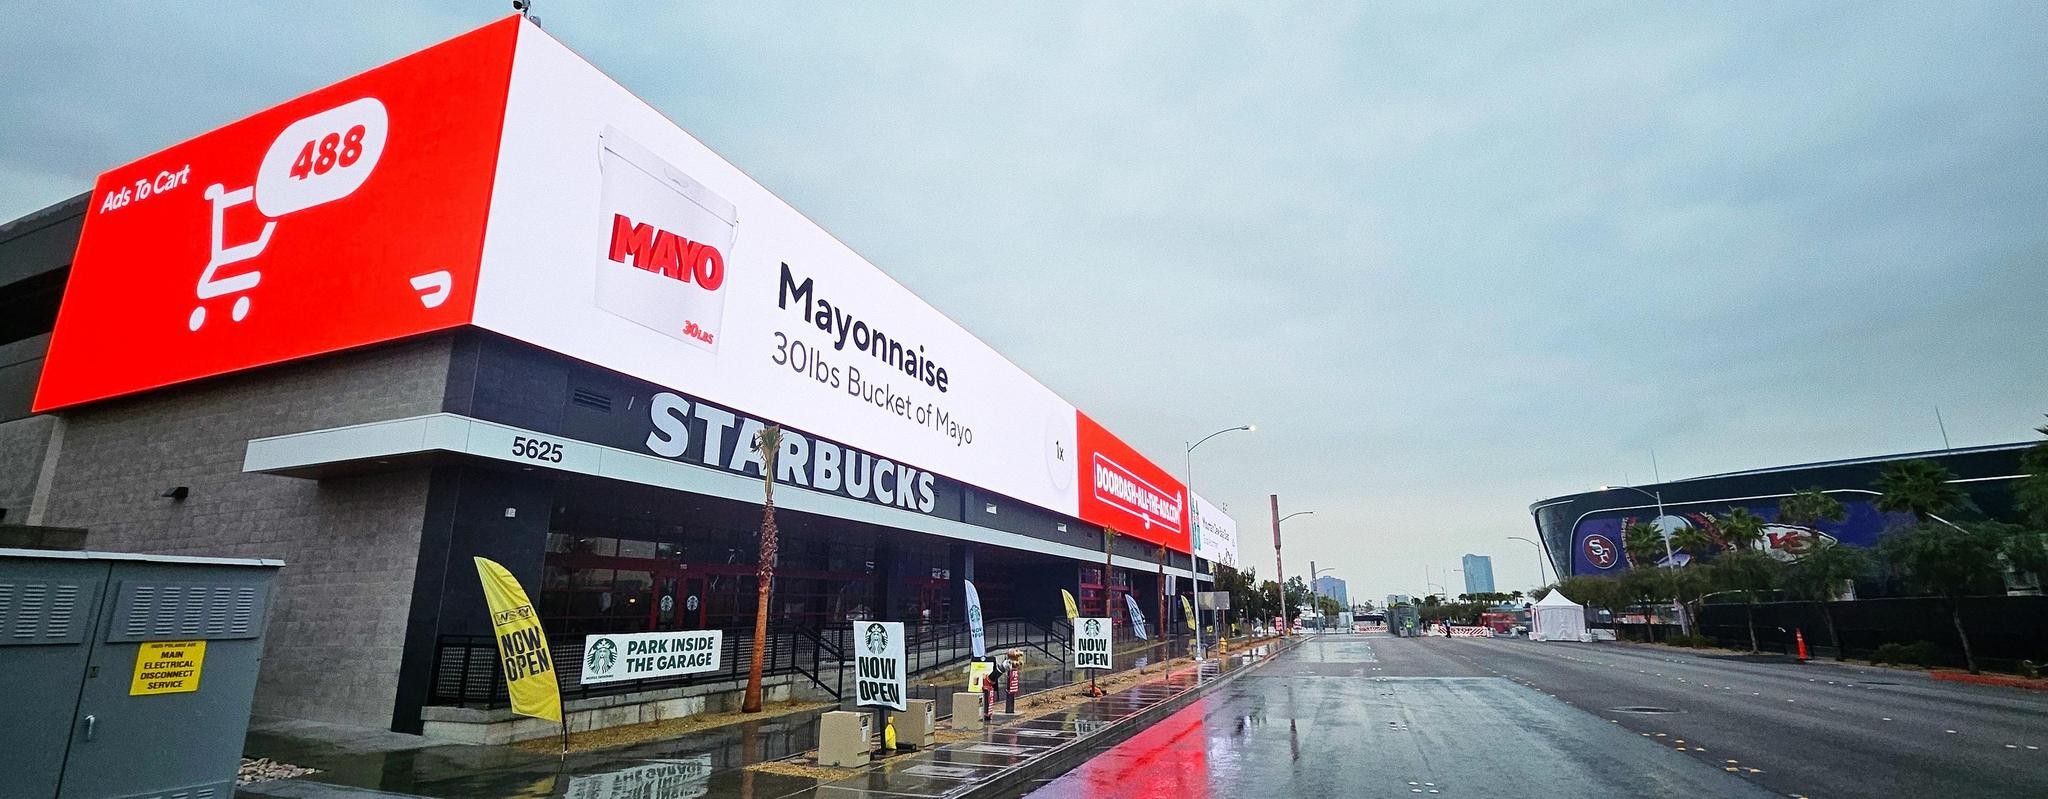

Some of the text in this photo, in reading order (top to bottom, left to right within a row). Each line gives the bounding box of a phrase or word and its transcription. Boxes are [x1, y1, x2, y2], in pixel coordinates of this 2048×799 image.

[289, 124, 366, 181] 488
[100, 164, 191, 214] Ads To Cart
[608, 213, 725, 291] MAYO
[778, 261, 948, 393] Mayonnaise
[772, 331, 973, 447] 30lbs Bucket of Mayo
[512, 436, 564, 464] 5625
[646, 392, 936, 514] STARBUCKS
[1055, 440, 1065, 462] 1x
[501, 625, 541, 658] NOW
[627, 637, 714, 655] PARK INSIDE
[1078, 638, 1107, 651] NOW
[144, 661, 194, 670] ELECTRICAL
[161, 651, 184, 659] MAIN
[505, 648, 550, 682] OPEN
[626, 652, 712, 673] THE GARAGE
[1078, 653, 1108, 666] OPEN
[140, 670, 194, 680] DISCONNECT
[859, 656, 896, 680] NOW
[147, 680, 183, 690] SERVICE
[859, 680, 900, 705] OPEN
